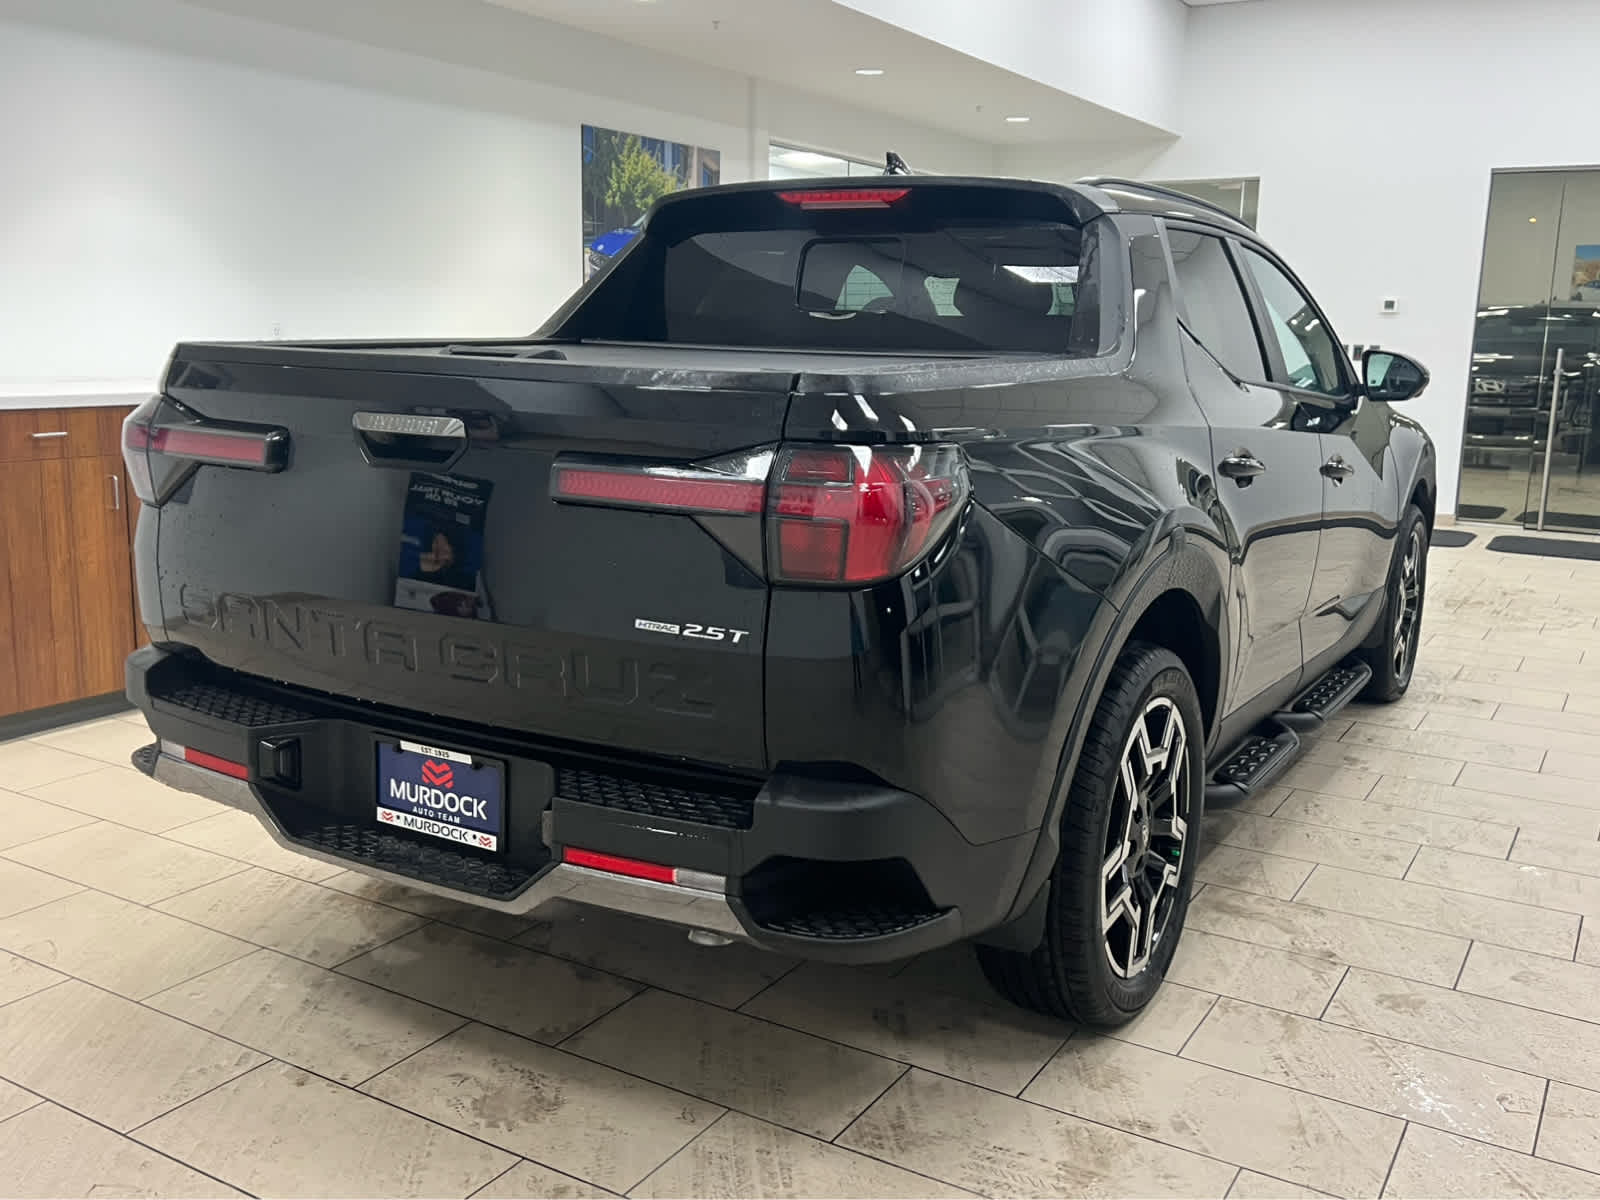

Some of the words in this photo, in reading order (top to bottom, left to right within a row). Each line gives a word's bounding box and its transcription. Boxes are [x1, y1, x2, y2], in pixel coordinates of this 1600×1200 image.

[390, 778, 488, 821] MURDOCK
[403, 815, 468, 842] MURDOCK
[412, 806, 433, 818] AUTO
[438, 811, 461, 824] TEAM
